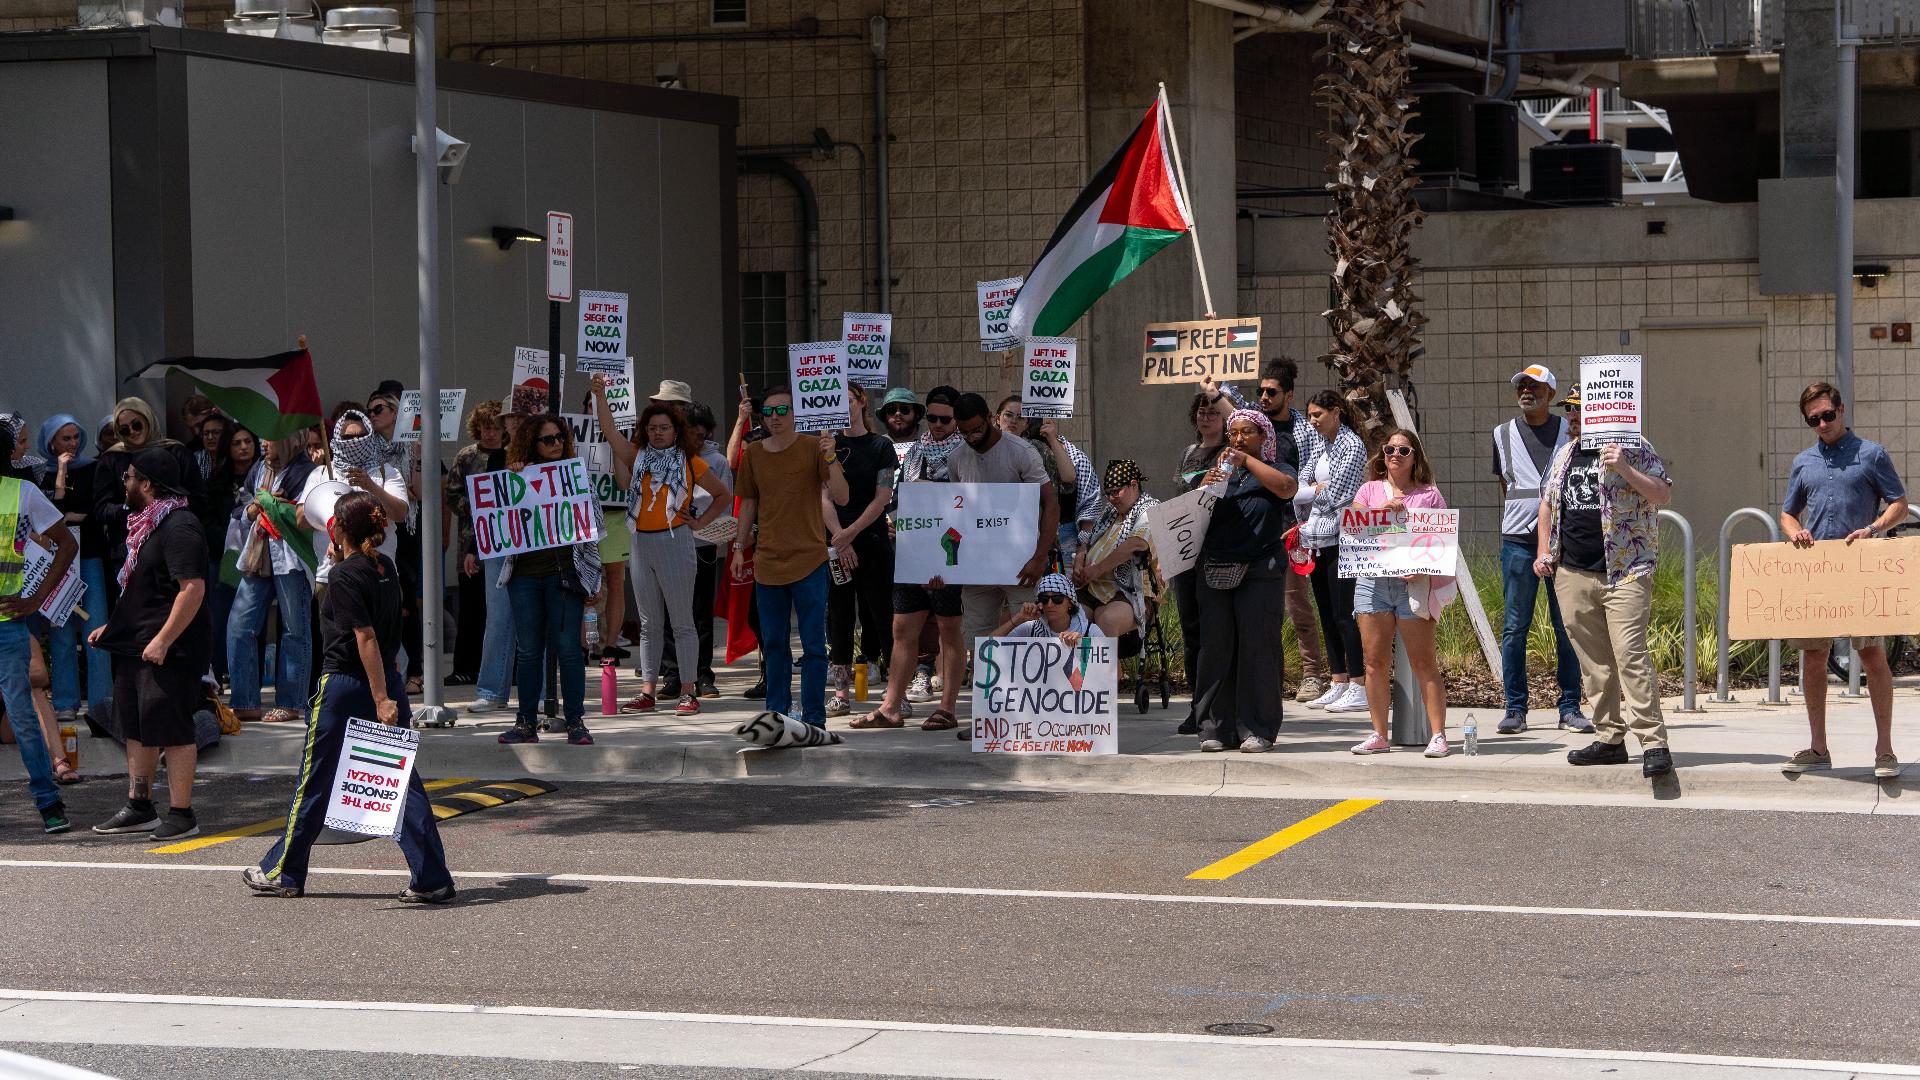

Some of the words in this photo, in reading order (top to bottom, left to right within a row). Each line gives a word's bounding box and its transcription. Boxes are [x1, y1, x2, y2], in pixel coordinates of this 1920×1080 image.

[986, 291, 1000, 299] LIFT
[588, 303, 603, 311] LIFT
[604, 304, 619, 312] THE
[983, 300, 1005, 308] SIEGE
[584, 313, 606, 322] SIEGE
[608, 315, 622, 323] ON
[985, 309, 1011, 321] GAZ
[585, 325, 621, 338] GAZA
[988, 323, 1008, 334] NO
[1177, 328, 1226, 350] FREE
[585, 340, 620, 353] NOW
[848, 344, 883, 356] GAZA
[518, 349, 538, 363] FREE
[1051, 349, 1067, 357] THE
[800, 356, 816, 365] LIFT
[818, 354, 836, 364] THE
[848, 358, 882, 370] NOW
[1029, 359, 1052, 368] SIEGE
[1055, 360, 1070, 368] ON
[1144, 352, 1256, 377] PALESTINE
[796, 367, 822, 377] SIEGE
[824, 366, 841, 375] ON
[1030, 370, 1069, 383] GAZA
[1600, 370, 1621, 378] NOT
[616, 377, 630, 386] ON
[798, 378, 841, 392] GAZA
[1587, 380, 1634, 390] ANOTHER
[606, 388, 629, 399] AZA
[1030, 386, 1067, 398] NOW
[1588, 392, 1611, 401] DIME
[1614, 391, 1634, 399] FOR
[608, 401, 629, 412] OW
[802, 395, 841, 409] NOW
[1585, 402, 1635, 412] GENOCIDE:
[473, 472, 526, 509] END
[540, 461, 589, 497] THE
[954, 495, 964, 508] 2
[1342, 508, 1391, 527] ANTI
[1396, 511, 1456, 525] GENOCIDE
[476, 500, 591, 554] OCCUPATION
[896, 518, 944, 531] RESIST
[976, 517, 1010, 529] EXIST
[1742, 549, 1845, 582] Netanyahu
[1859, 549, 1905, 575] Lies
[22, 555, 47, 592] ANOTHER
[1746, 588, 1854, 624] Palestinians
[1862, 586, 1910, 616] DIE
[1077, 646, 1109, 664] THE
[988, 687, 1110, 714] GENOCIDE
[975, 717, 1009, 739] END
[1013, 722, 1032, 739] THE
[1038, 720, 1111, 737] OCCUPATION
[347, 768, 384, 785] GAZA!
[386, 778, 399, 788] IN
[341, 781, 398, 800] GENOCIDE
[341, 794, 361, 808] THE
[363, 800, 392, 812] STOP
